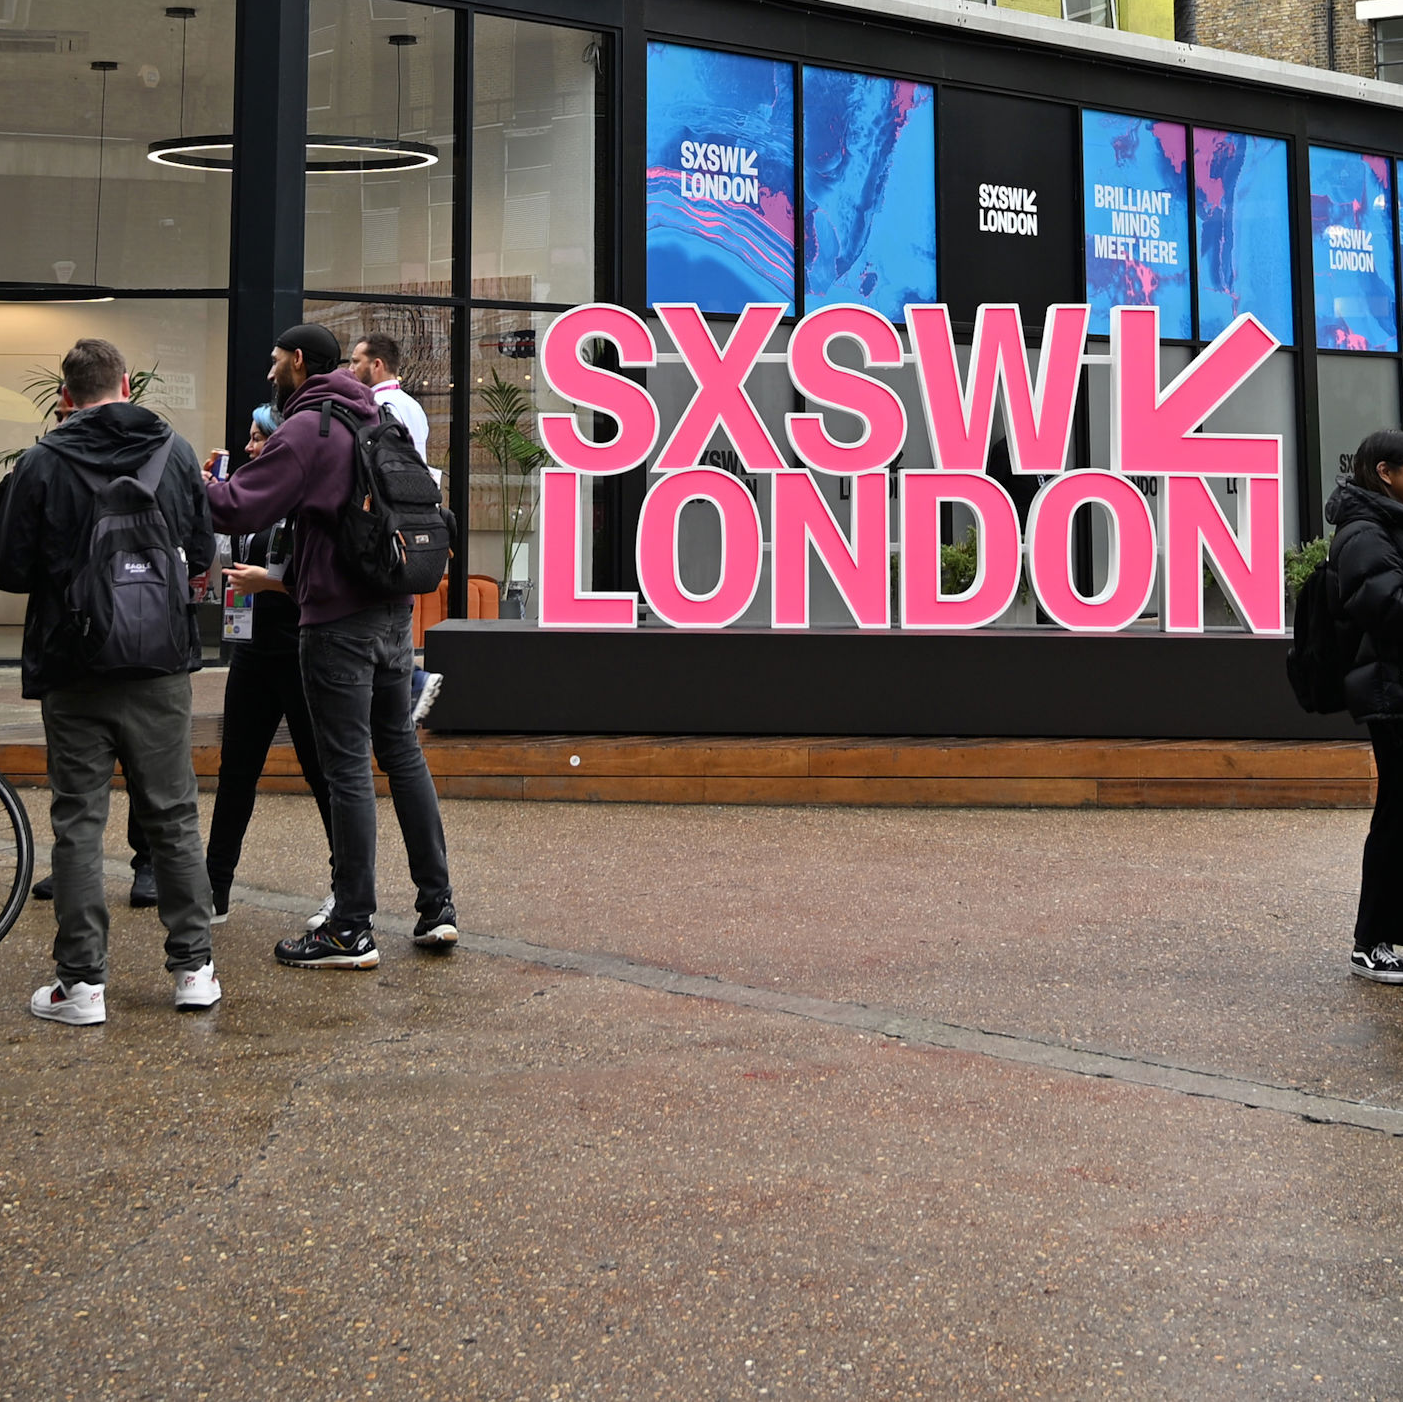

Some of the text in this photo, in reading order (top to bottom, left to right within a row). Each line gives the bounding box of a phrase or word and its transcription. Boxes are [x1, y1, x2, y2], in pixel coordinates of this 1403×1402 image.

[680, 139, 741, 175] SXSW
[680, 169, 759, 205] LONDON
[978, 182, 1026, 212] SXSW
[1094, 183, 1171, 216] BRILLIANT
[979, 207, 1038, 237] LONDON
[1111, 209, 1160, 239] MINDS
[1094, 234, 1178, 265] MEET HERE
[1328, 226, 1363, 251] SXSW
[1329, 248, 1375, 273] LONDON
[538, 302, 1091, 476] SXSW
[538, 466, 1286, 634] LONDON
